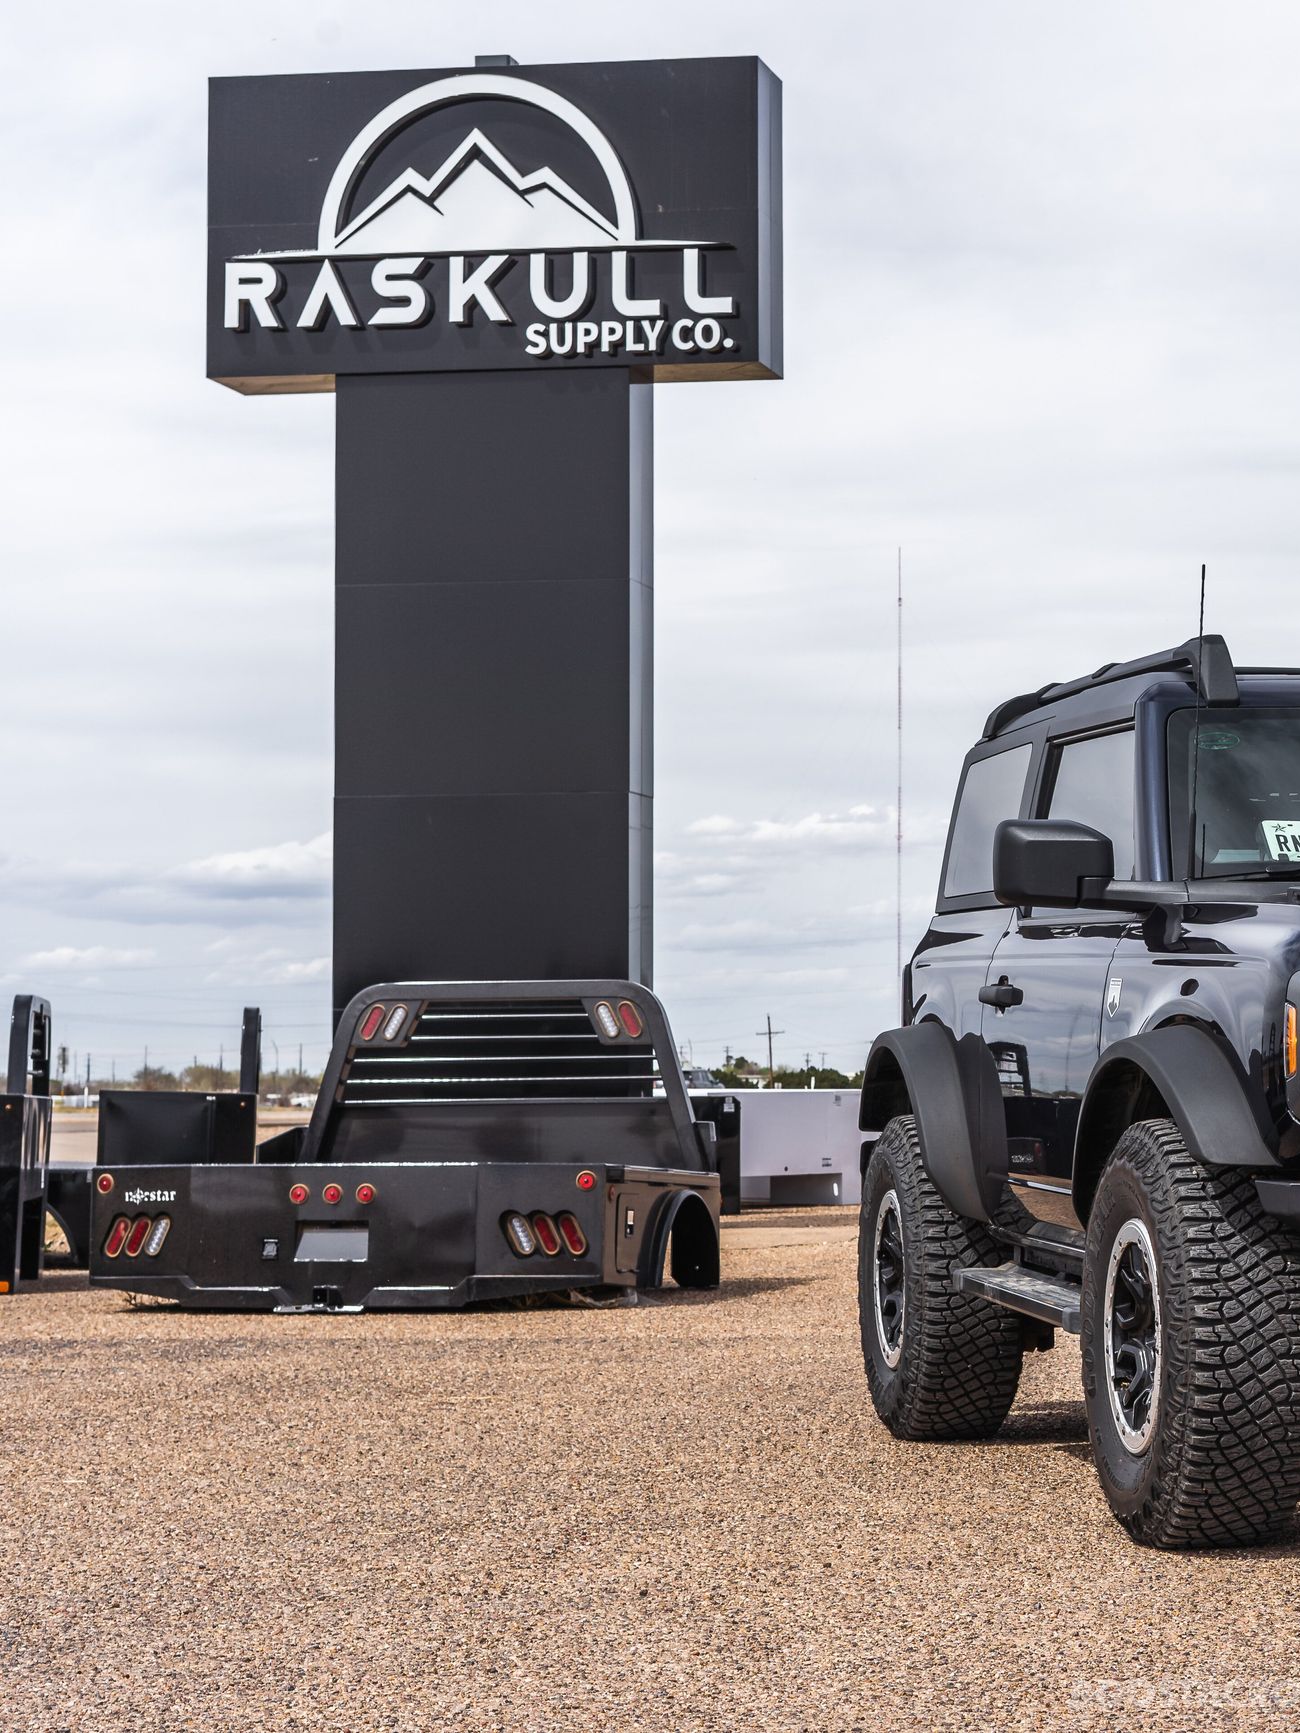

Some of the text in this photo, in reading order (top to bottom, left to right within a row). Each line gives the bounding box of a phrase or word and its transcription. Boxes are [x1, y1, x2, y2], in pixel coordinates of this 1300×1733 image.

[223, 248, 735, 329] RASKULL
[524, 318, 735, 355] SUPPLY CO.
